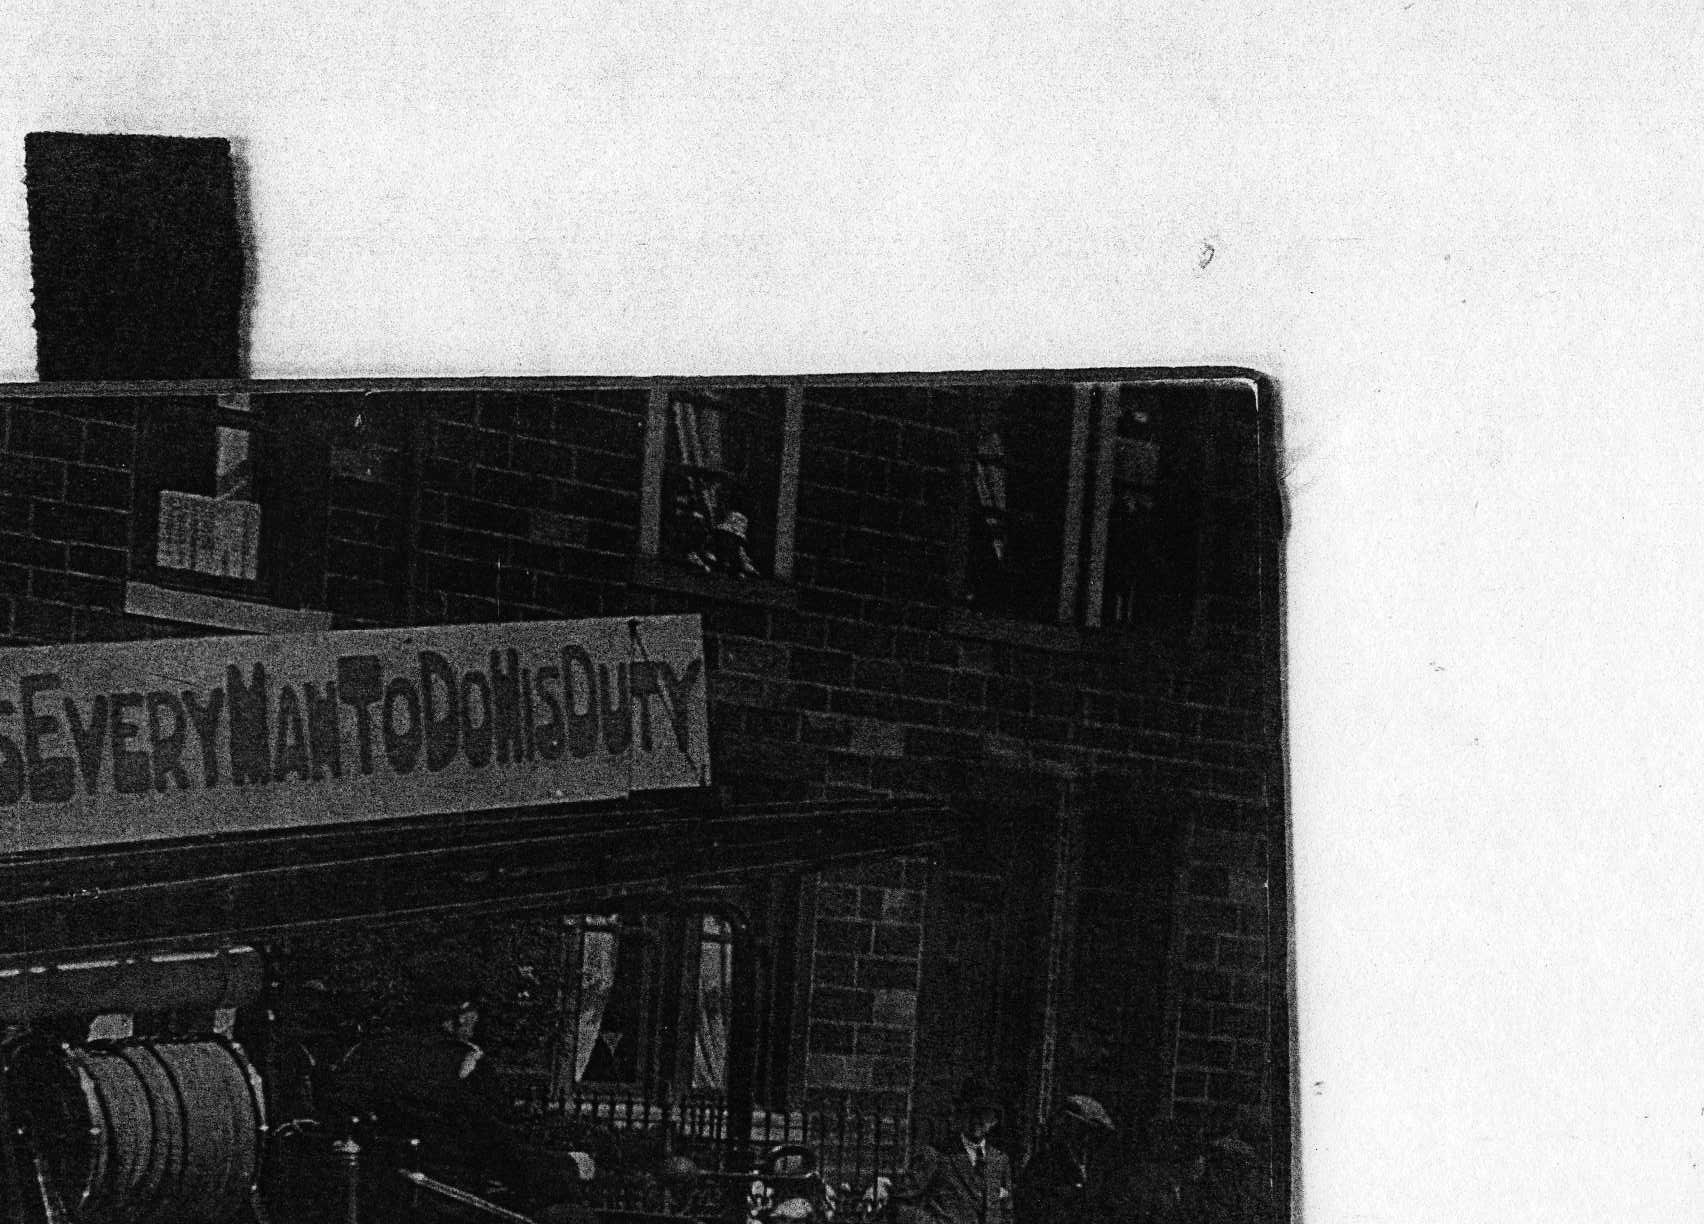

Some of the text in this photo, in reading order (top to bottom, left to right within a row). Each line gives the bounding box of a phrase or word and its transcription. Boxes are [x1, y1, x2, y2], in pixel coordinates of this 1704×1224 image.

[19, 671, 224, 802] EVERY
[226, 662, 342, 787] MAN
[338, 655, 421, 775] TO
[418, 650, 494, 772] DO
[491, 647, 562, 763] HIS
[559, 644, 703, 772] DUTY
